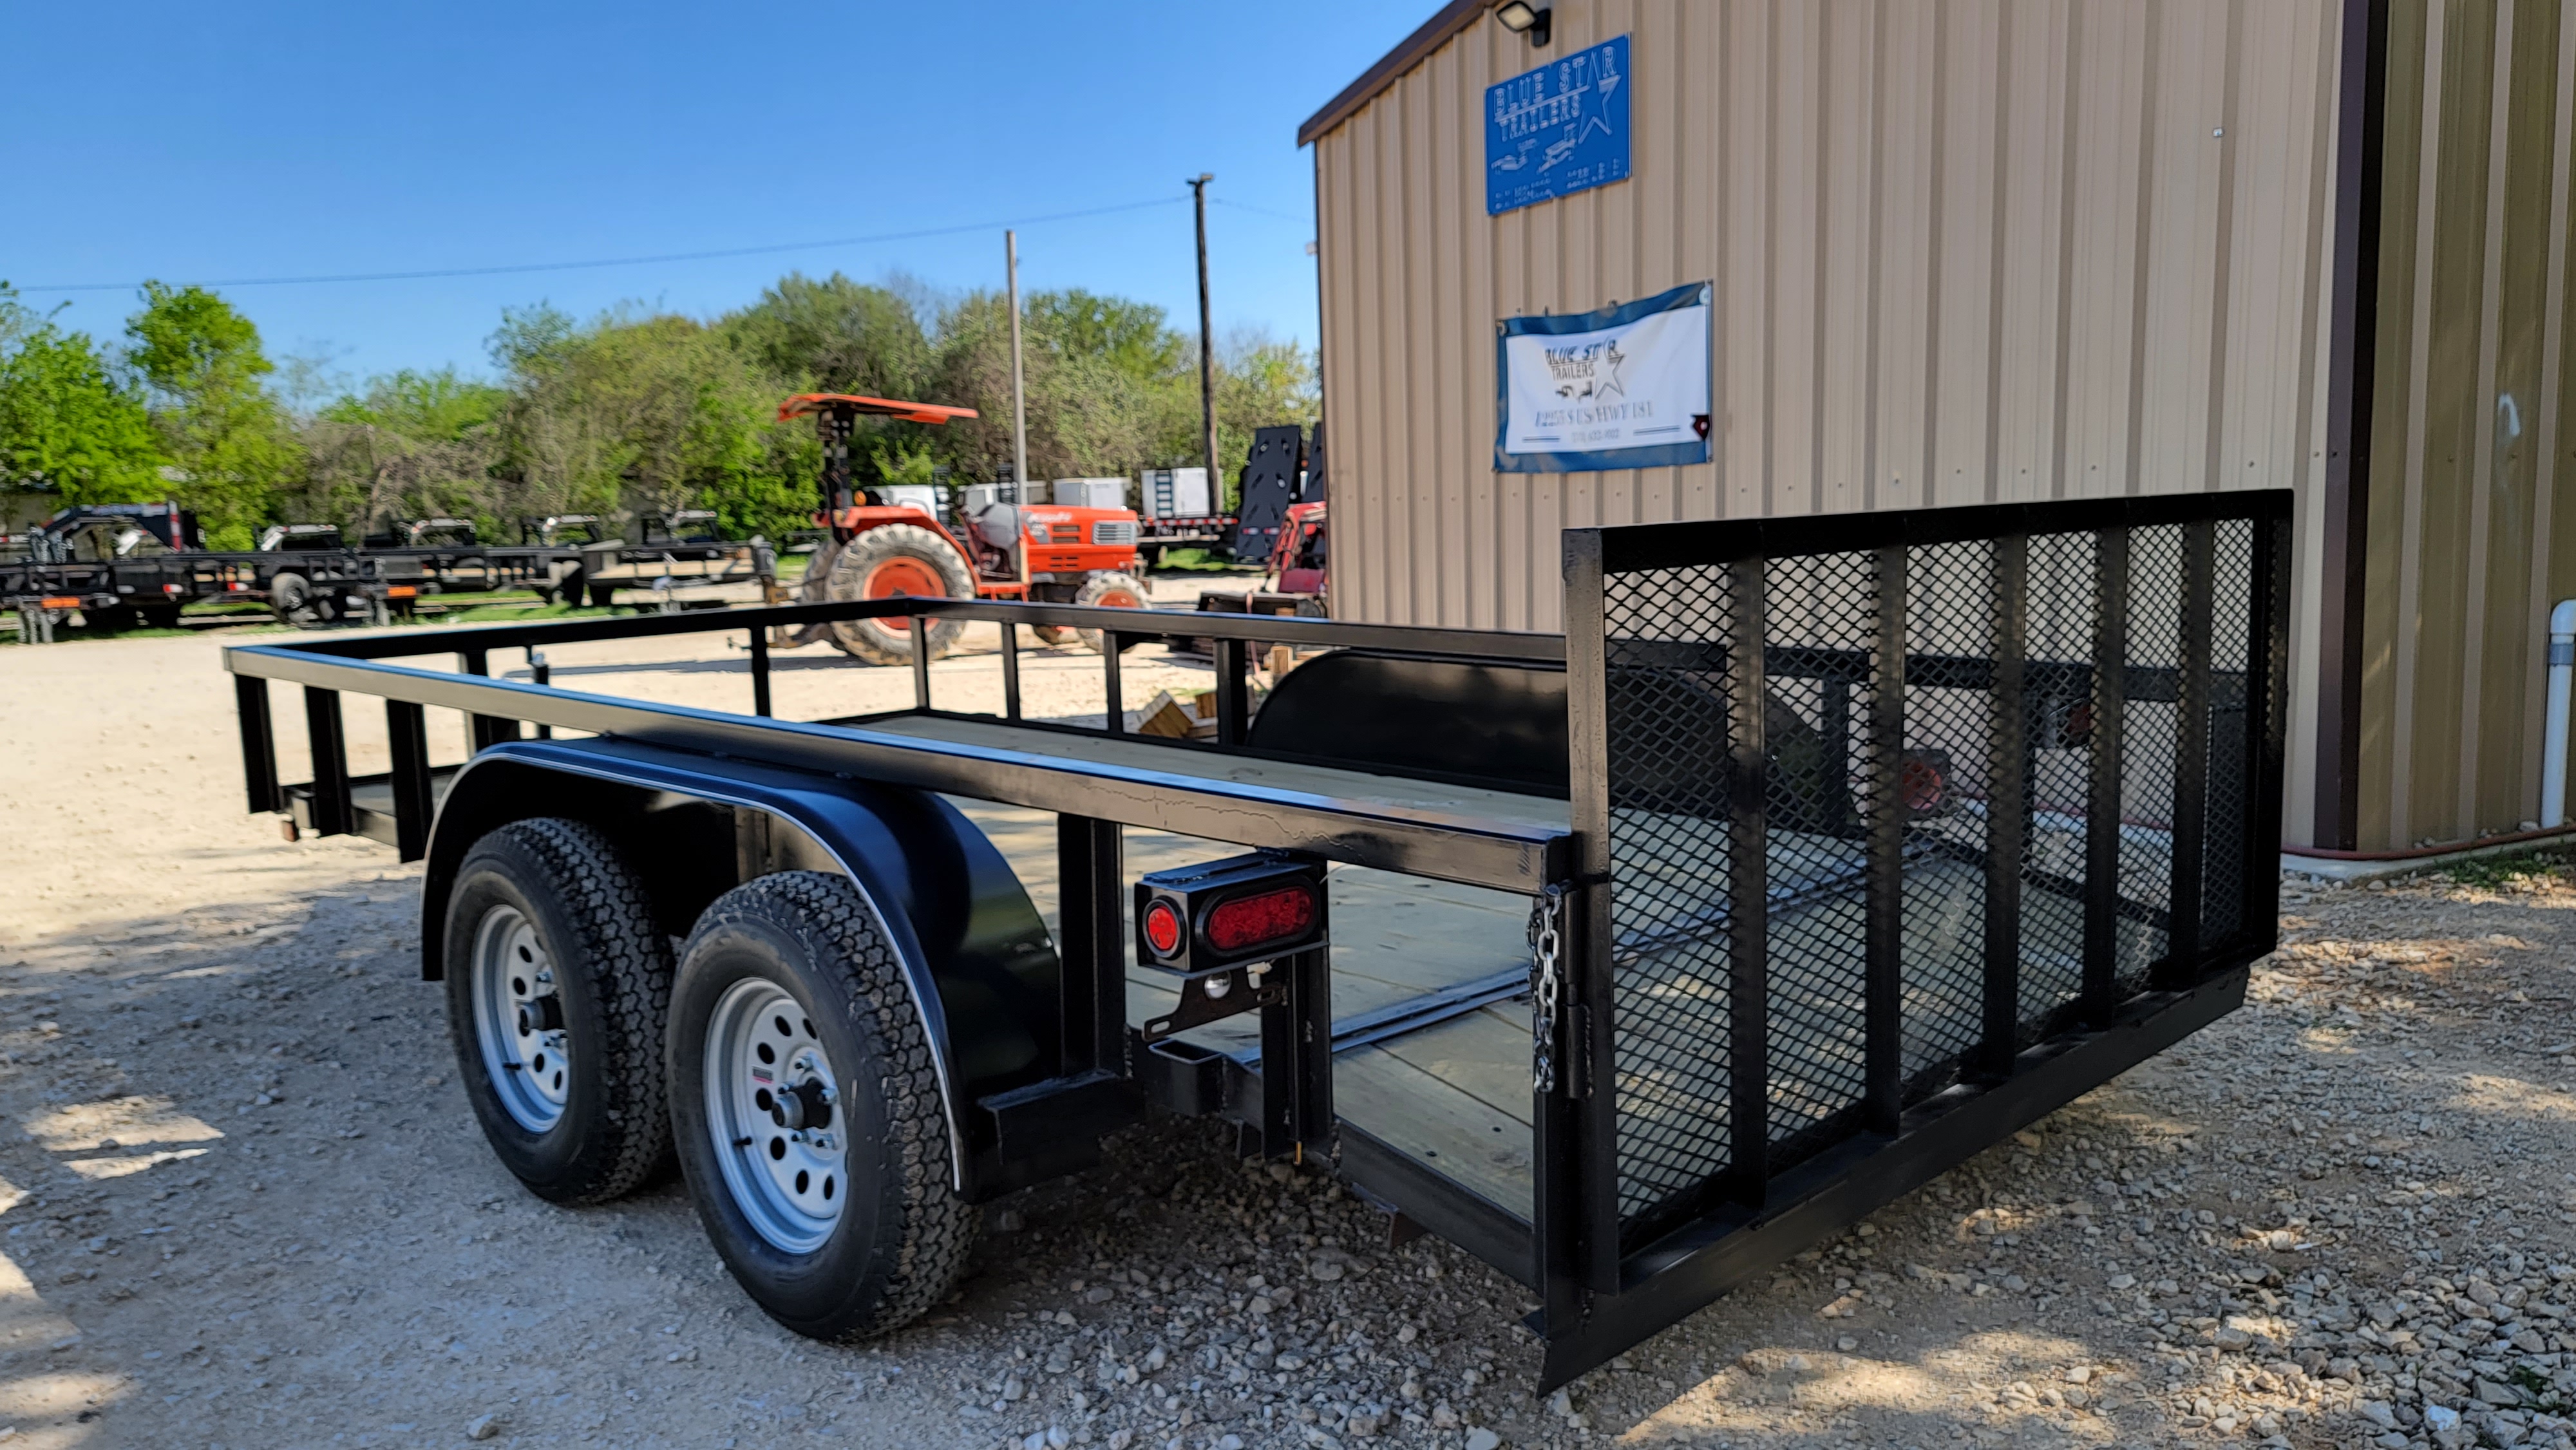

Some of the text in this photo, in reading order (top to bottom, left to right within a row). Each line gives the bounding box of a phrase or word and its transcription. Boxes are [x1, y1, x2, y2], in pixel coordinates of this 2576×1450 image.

[1493, 46, 1617, 117] BLUE STAR
[1499, 95, 1582, 142] TRAILERS
[1545, 345, 1577, 365] BLUE
[1551, 364, 1595, 381] TRAILERS
[1576, 407, 1593, 426] US
[1595, 404, 1629, 423] HWY
